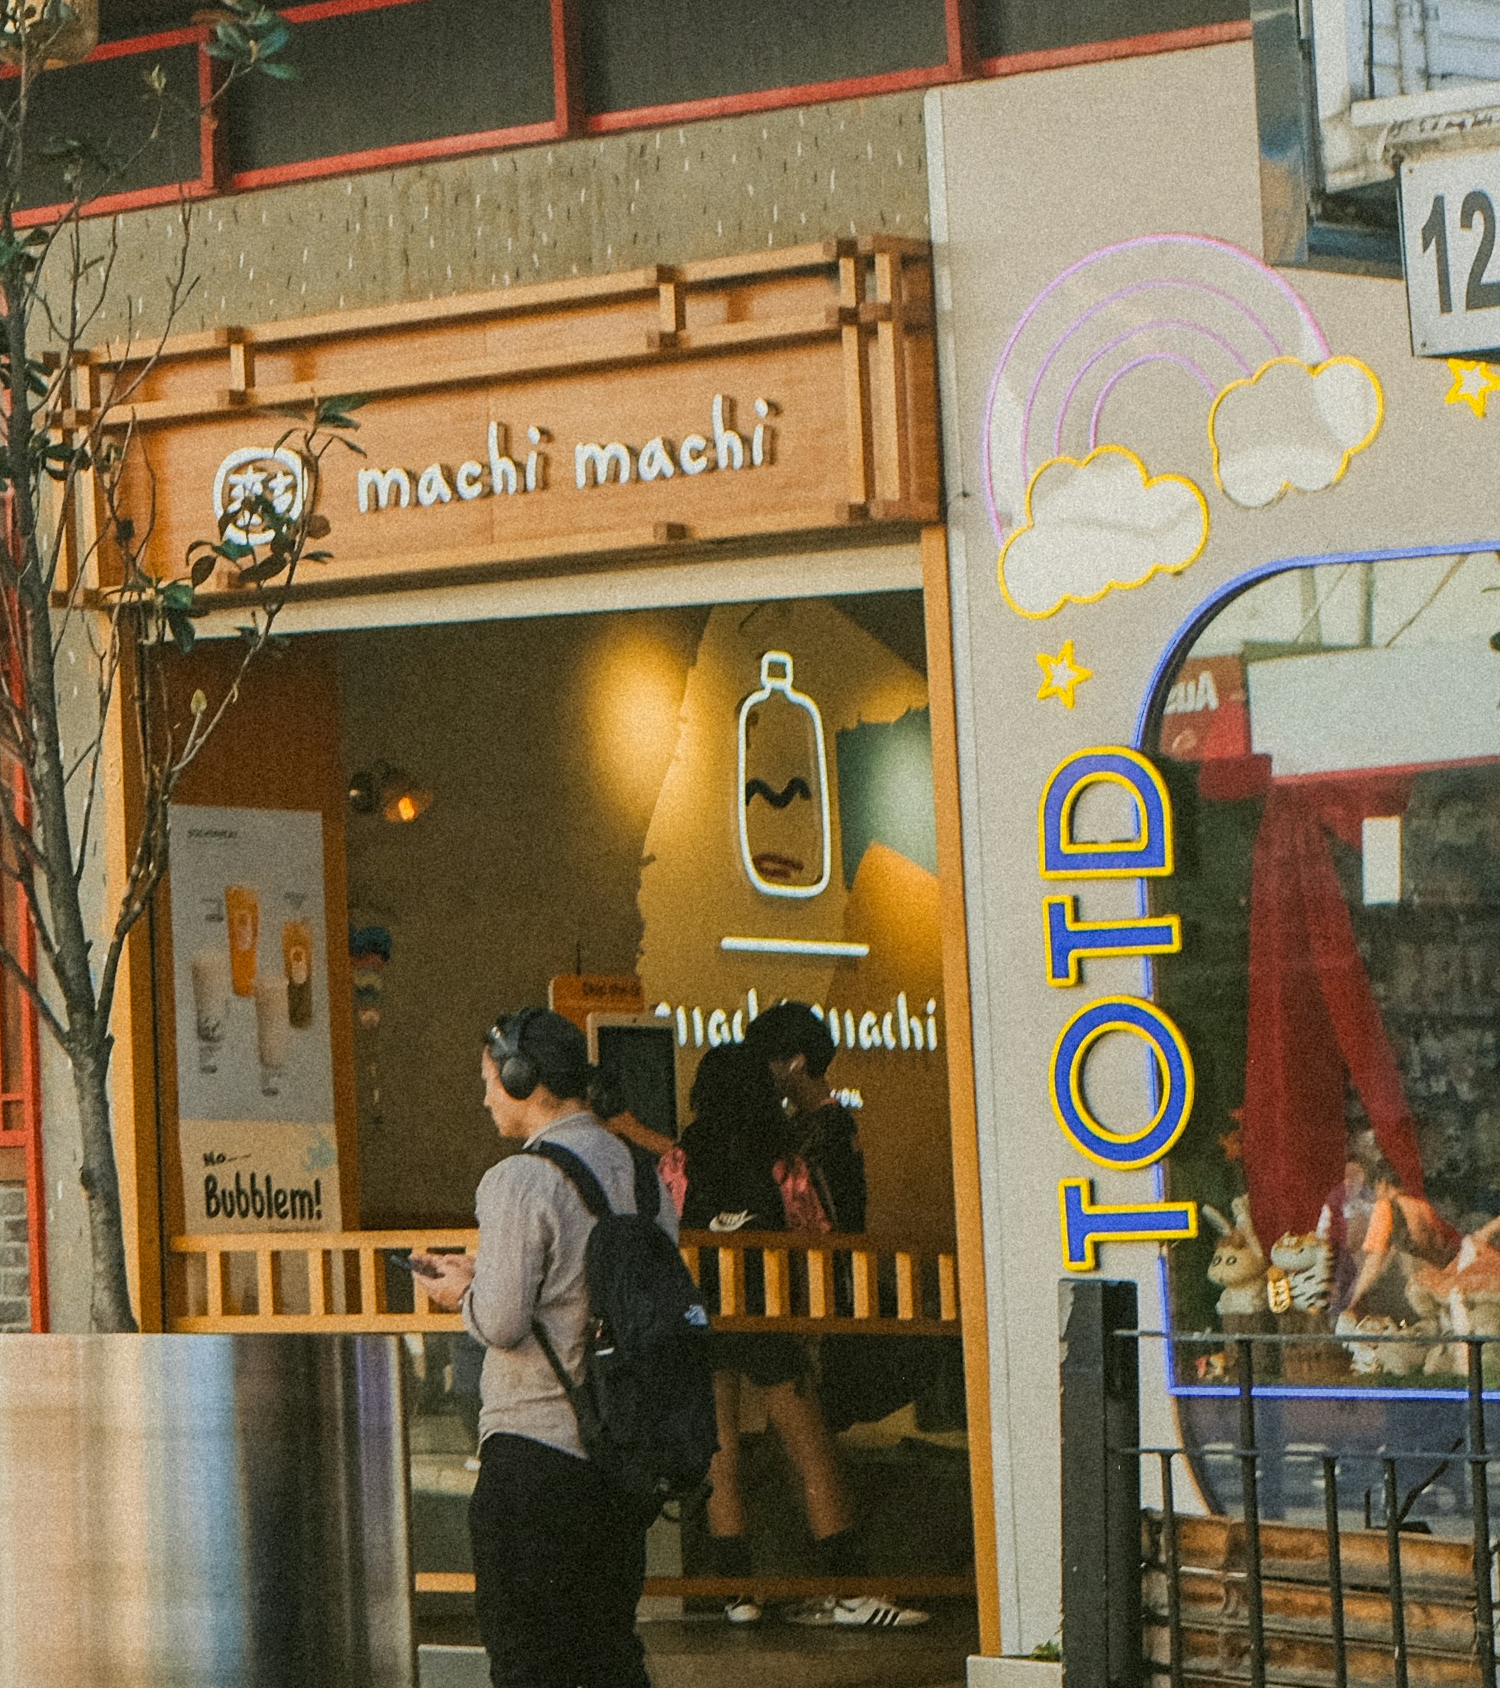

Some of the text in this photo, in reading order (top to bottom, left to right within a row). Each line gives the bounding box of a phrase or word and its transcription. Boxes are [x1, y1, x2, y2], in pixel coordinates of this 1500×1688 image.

[358, 393, 771, 513] machi machi
[1039, 743, 1198, 1276] TOTD
[205, 1170, 323, 1220] Bubblem!
